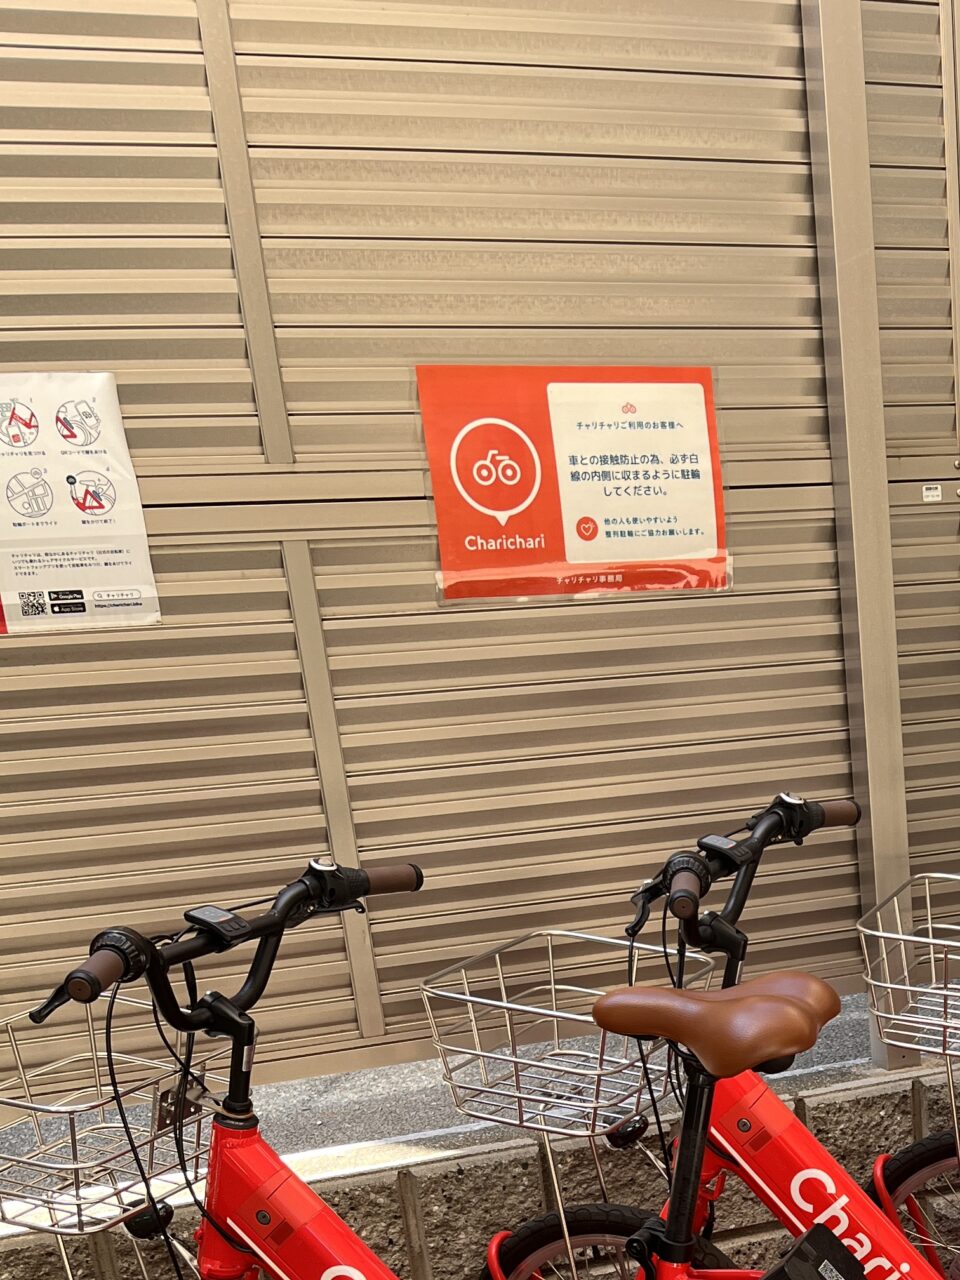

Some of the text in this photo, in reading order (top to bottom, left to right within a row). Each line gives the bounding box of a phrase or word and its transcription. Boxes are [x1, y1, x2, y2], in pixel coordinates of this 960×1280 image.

[576, 421, 684, 431] チャリチャリご利用のお客様へ
[568, 453, 699, 466] 車との接触防止の為、必ず白
[570, 469, 701, 482] 線の内側に収まるように駐輪
[603, 485, 668, 497] してください。
[604, 517, 678, 526] 他の人も使いやすいよう
[605, 528, 705, 538] 整列駐輪にご協力お願いします。
[464, 534, 545, 551] Charichari
